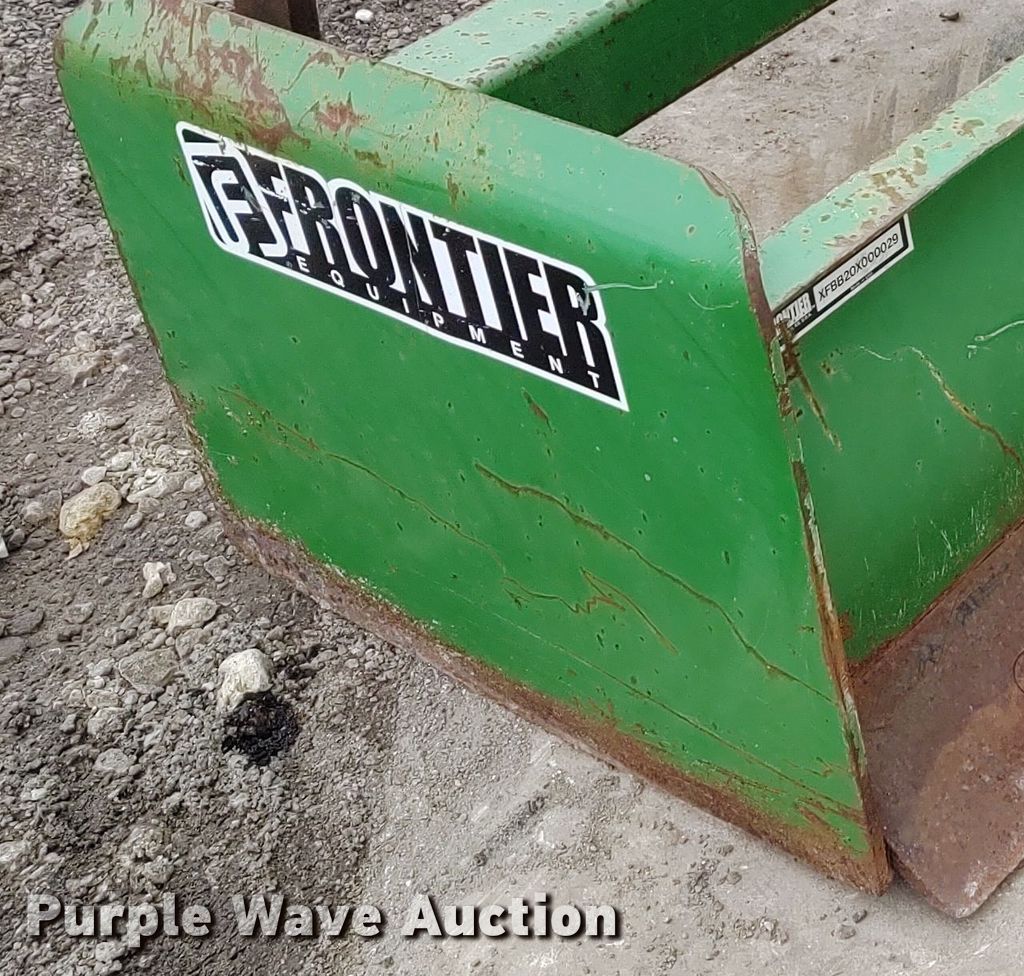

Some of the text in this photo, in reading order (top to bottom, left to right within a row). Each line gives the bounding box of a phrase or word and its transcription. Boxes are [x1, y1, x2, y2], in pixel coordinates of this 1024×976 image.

[240, 146, 606, 370] FRONTIER
[295, 255, 600, 389] EQUIPMENT
[818, 233, 899, 301] XFBB20X000029
